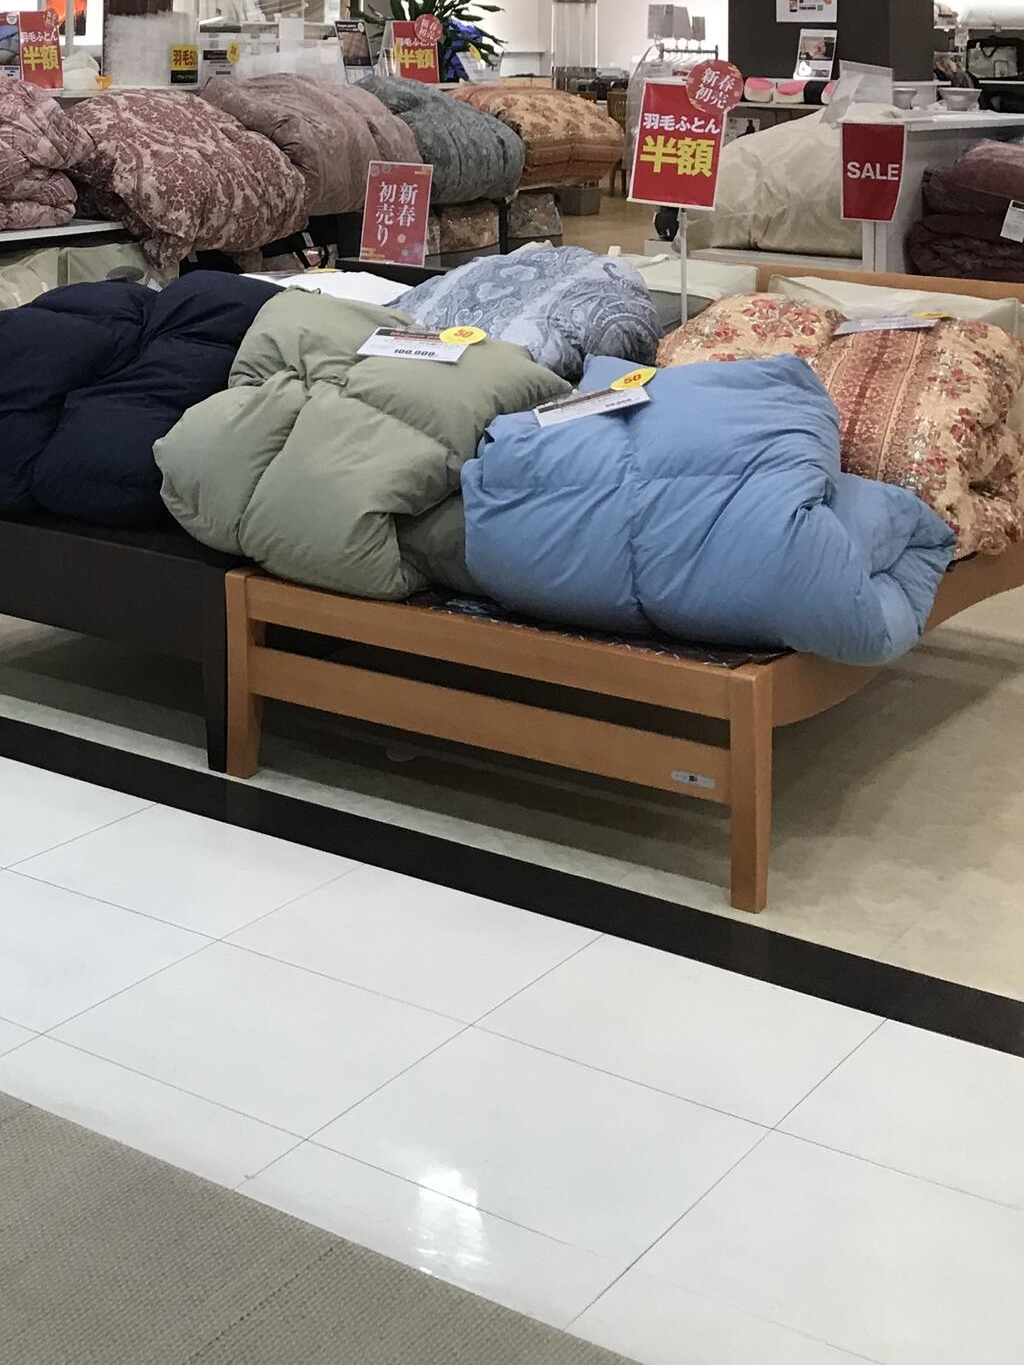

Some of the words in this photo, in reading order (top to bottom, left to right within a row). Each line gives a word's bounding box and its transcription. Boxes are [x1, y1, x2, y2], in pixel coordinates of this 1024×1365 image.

[23, 44, 60, 72] 半額
[399, 48, 436, 69] 半額
[702, 67, 736, 92] 新春
[642, 113, 721, 134] 羽毛ふとん
[640, 135, 716, 178] 半額
[846, 161, 900, 181] SALE
[376, 181, 397, 247] 初売り
[397, 182, 419, 227] 新春
